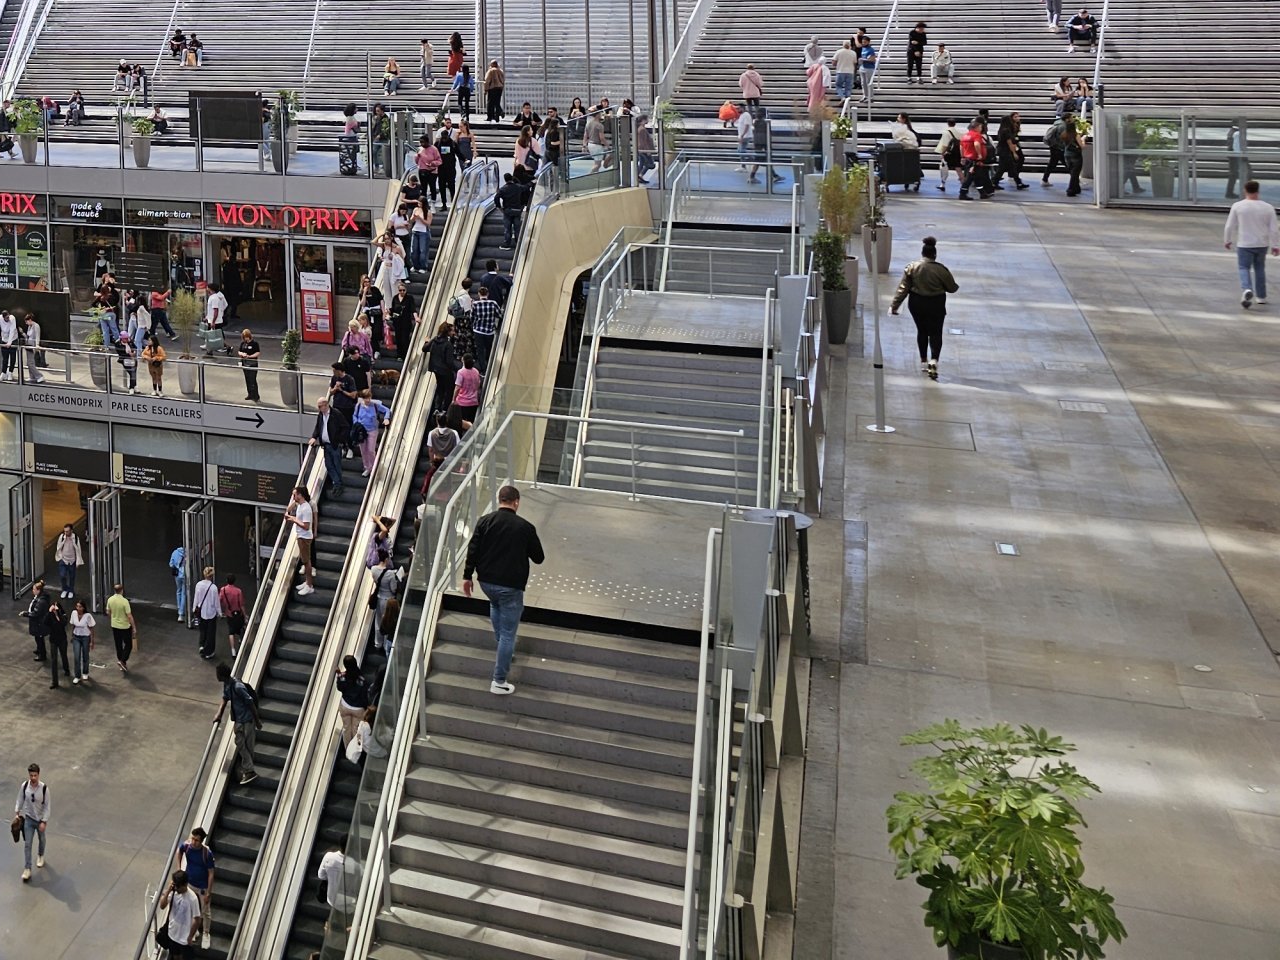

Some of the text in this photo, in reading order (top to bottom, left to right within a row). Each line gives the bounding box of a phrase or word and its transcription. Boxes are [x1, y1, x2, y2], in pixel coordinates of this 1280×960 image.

[70, 201, 103, 211] mode &
[71, 208, 100, 218] beauté
[215, 203, 360, 231] MONOPRIX
[28, 392, 202, 419] ACCÈS MONOPRIX PAR LES ESCALIERS
